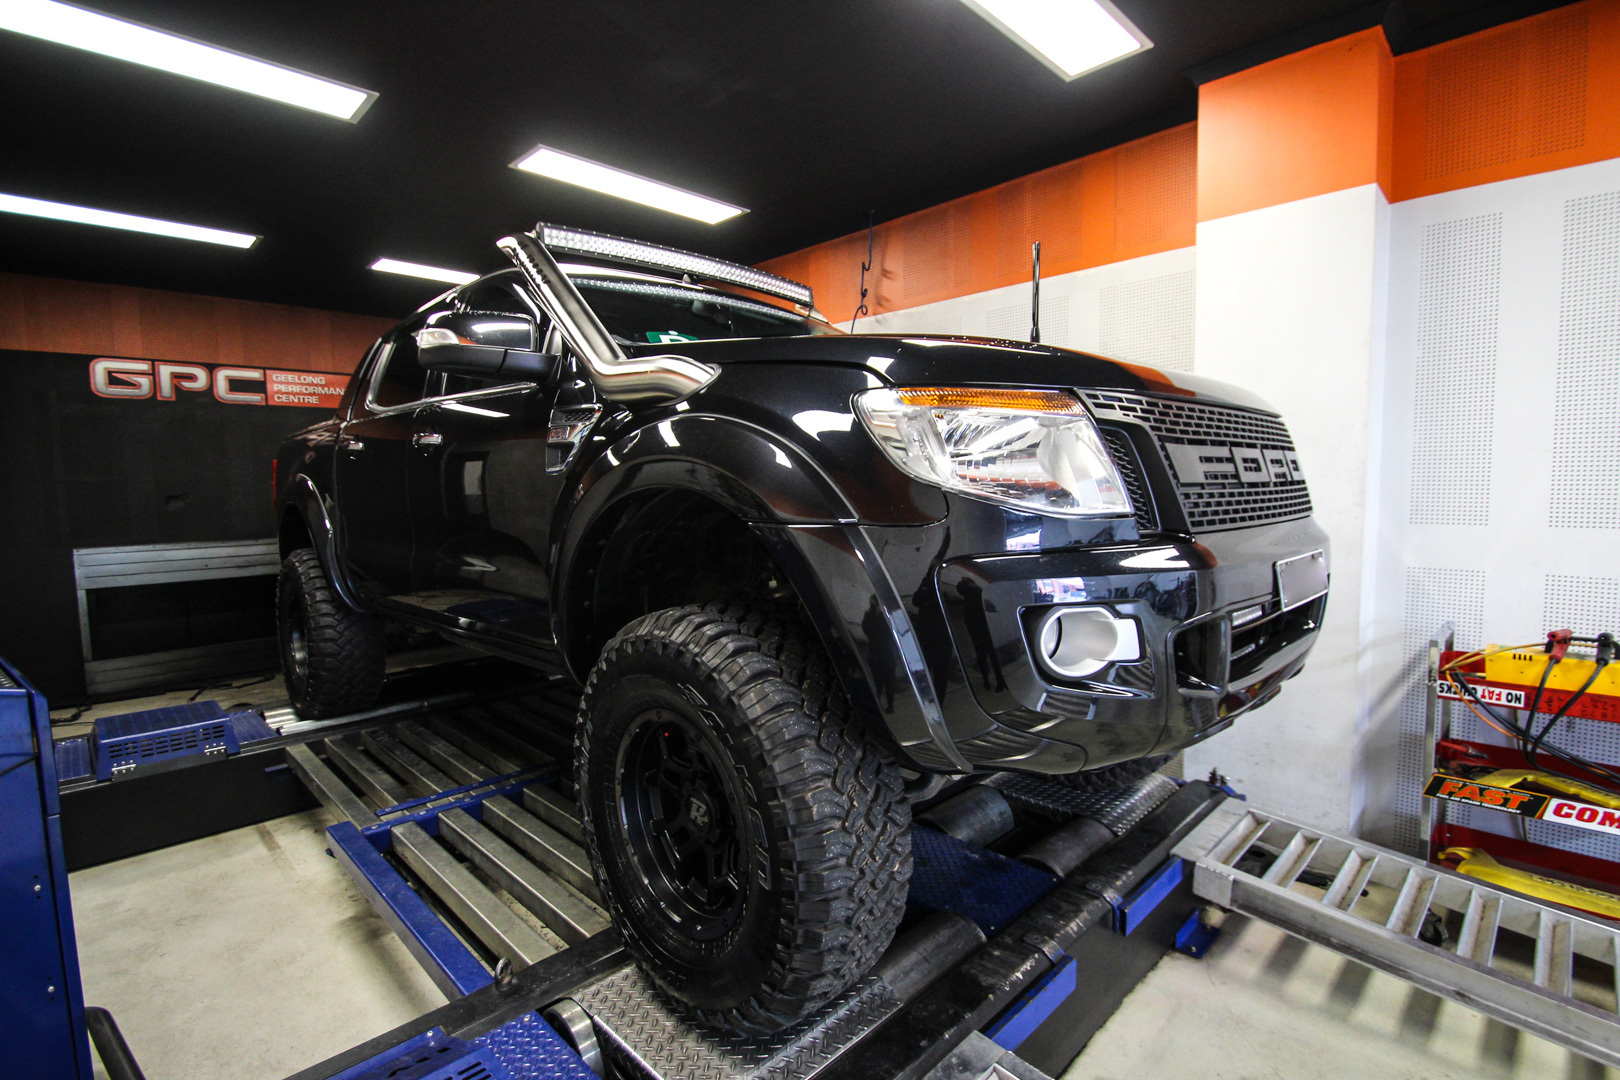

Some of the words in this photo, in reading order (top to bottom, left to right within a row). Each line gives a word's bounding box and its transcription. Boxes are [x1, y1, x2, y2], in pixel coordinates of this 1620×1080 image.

[89, 357, 266, 406] GPC
[273, 373, 326, 385] GEELONG
[274, 384, 345, 396] PERFORMAN
[274, 394, 319, 404] CENTRE
[1481, 687, 1502, 701] FAT
[1506, 691, 1522, 704] NO
[1440, 781, 1530, 809] FAST
[1553, 802, 1620, 829] COM
